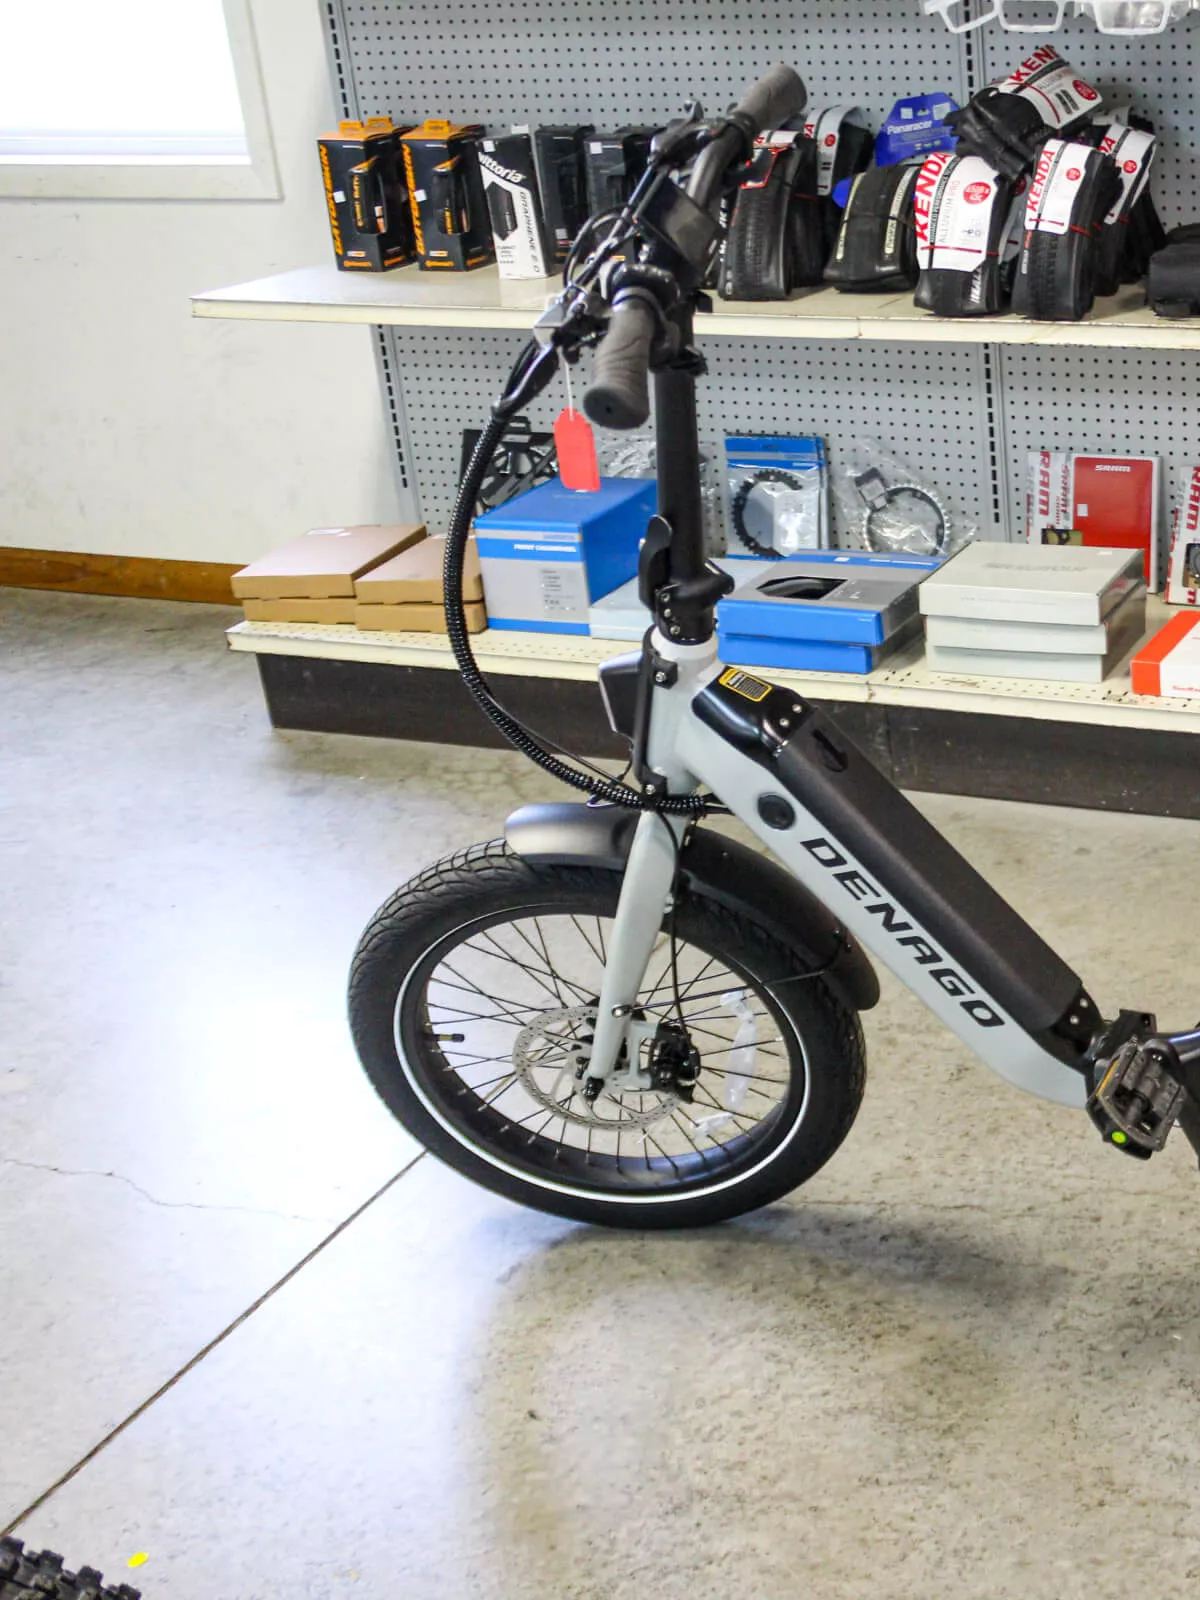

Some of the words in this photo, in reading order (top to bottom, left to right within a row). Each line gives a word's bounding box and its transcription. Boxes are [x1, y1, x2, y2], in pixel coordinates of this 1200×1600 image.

[1008, 44, 1059, 82] KEN
[887, 120, 933, 135] Panaracer
[478, 152, 524, 183] vittoria
[1026, 149, 1055, 213] KENDA
[914, 152, 951, 242] KENDA
[1095, 464, 1131, 473] SRAM
[800, 837, 1005, 1028] DENAGO
